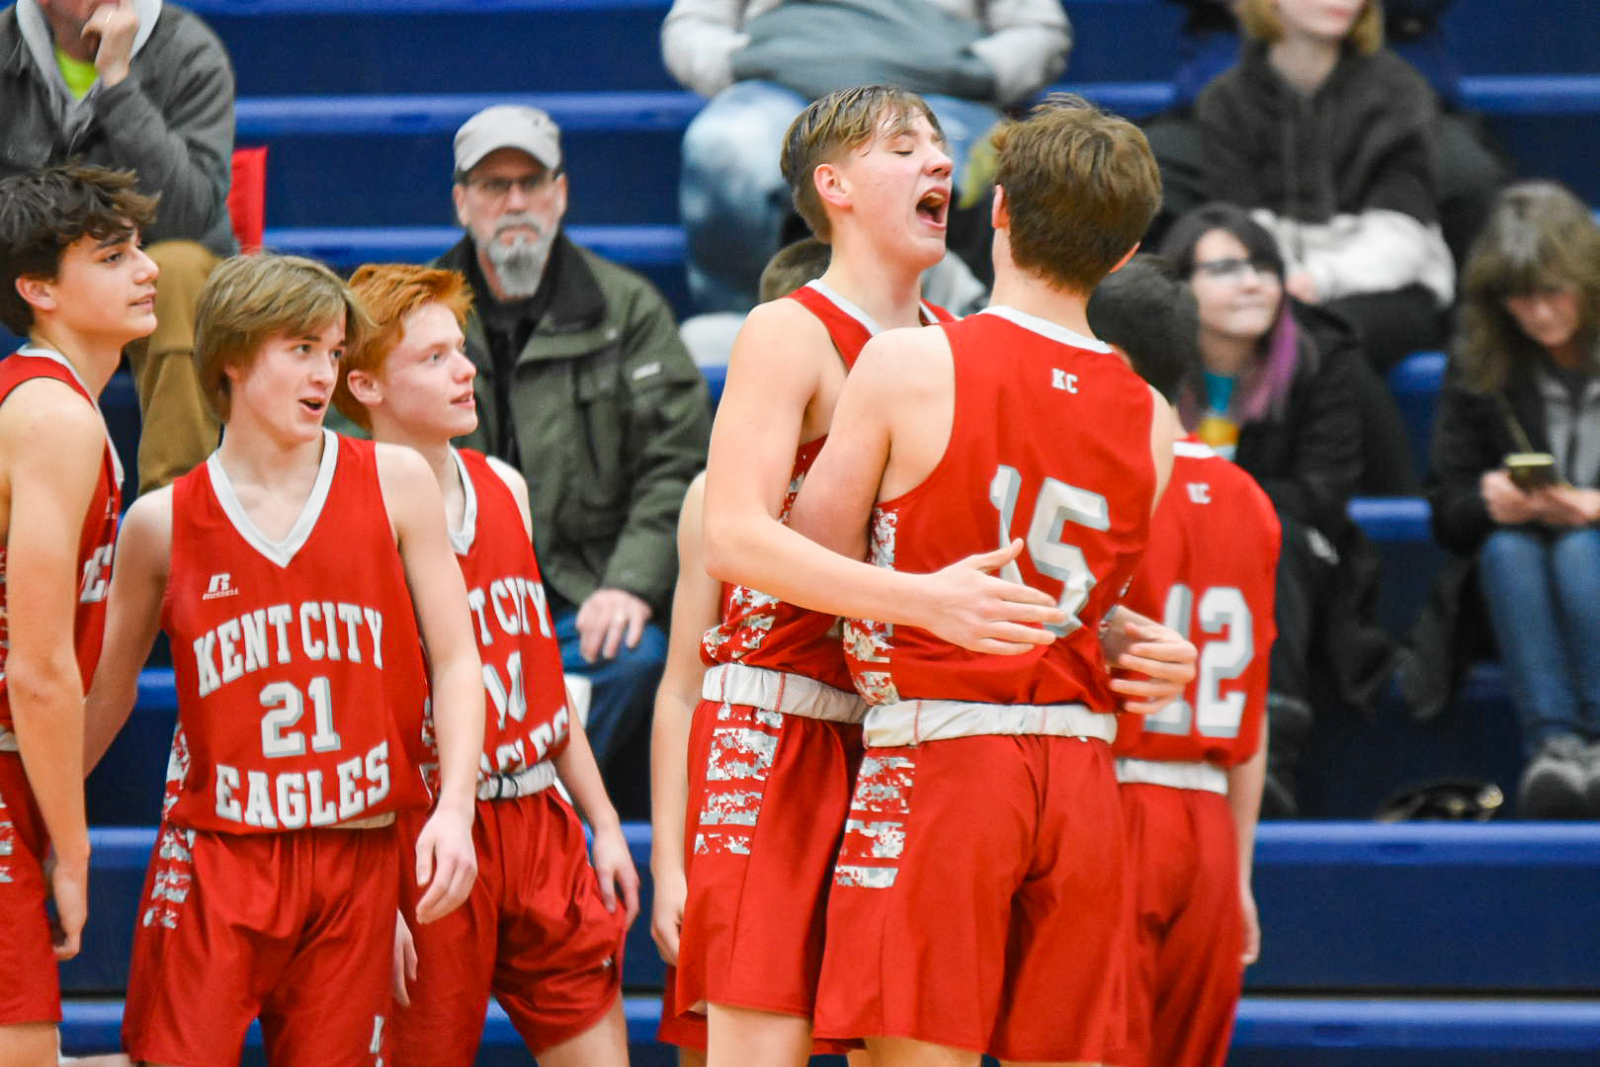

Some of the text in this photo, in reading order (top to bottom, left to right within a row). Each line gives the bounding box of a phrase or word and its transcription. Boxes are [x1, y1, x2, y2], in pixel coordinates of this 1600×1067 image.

[1052, 368, 1078, 394] KC
[989, 464, 1111, 638] 15
[193, 604, 292, 698] KENT
[299, 601, 383, 669] CITY
[1143, 584, 1253, 738] 12
[259, 676, 341, 758] 21
[215, 741, 391, 829] EAGLES
